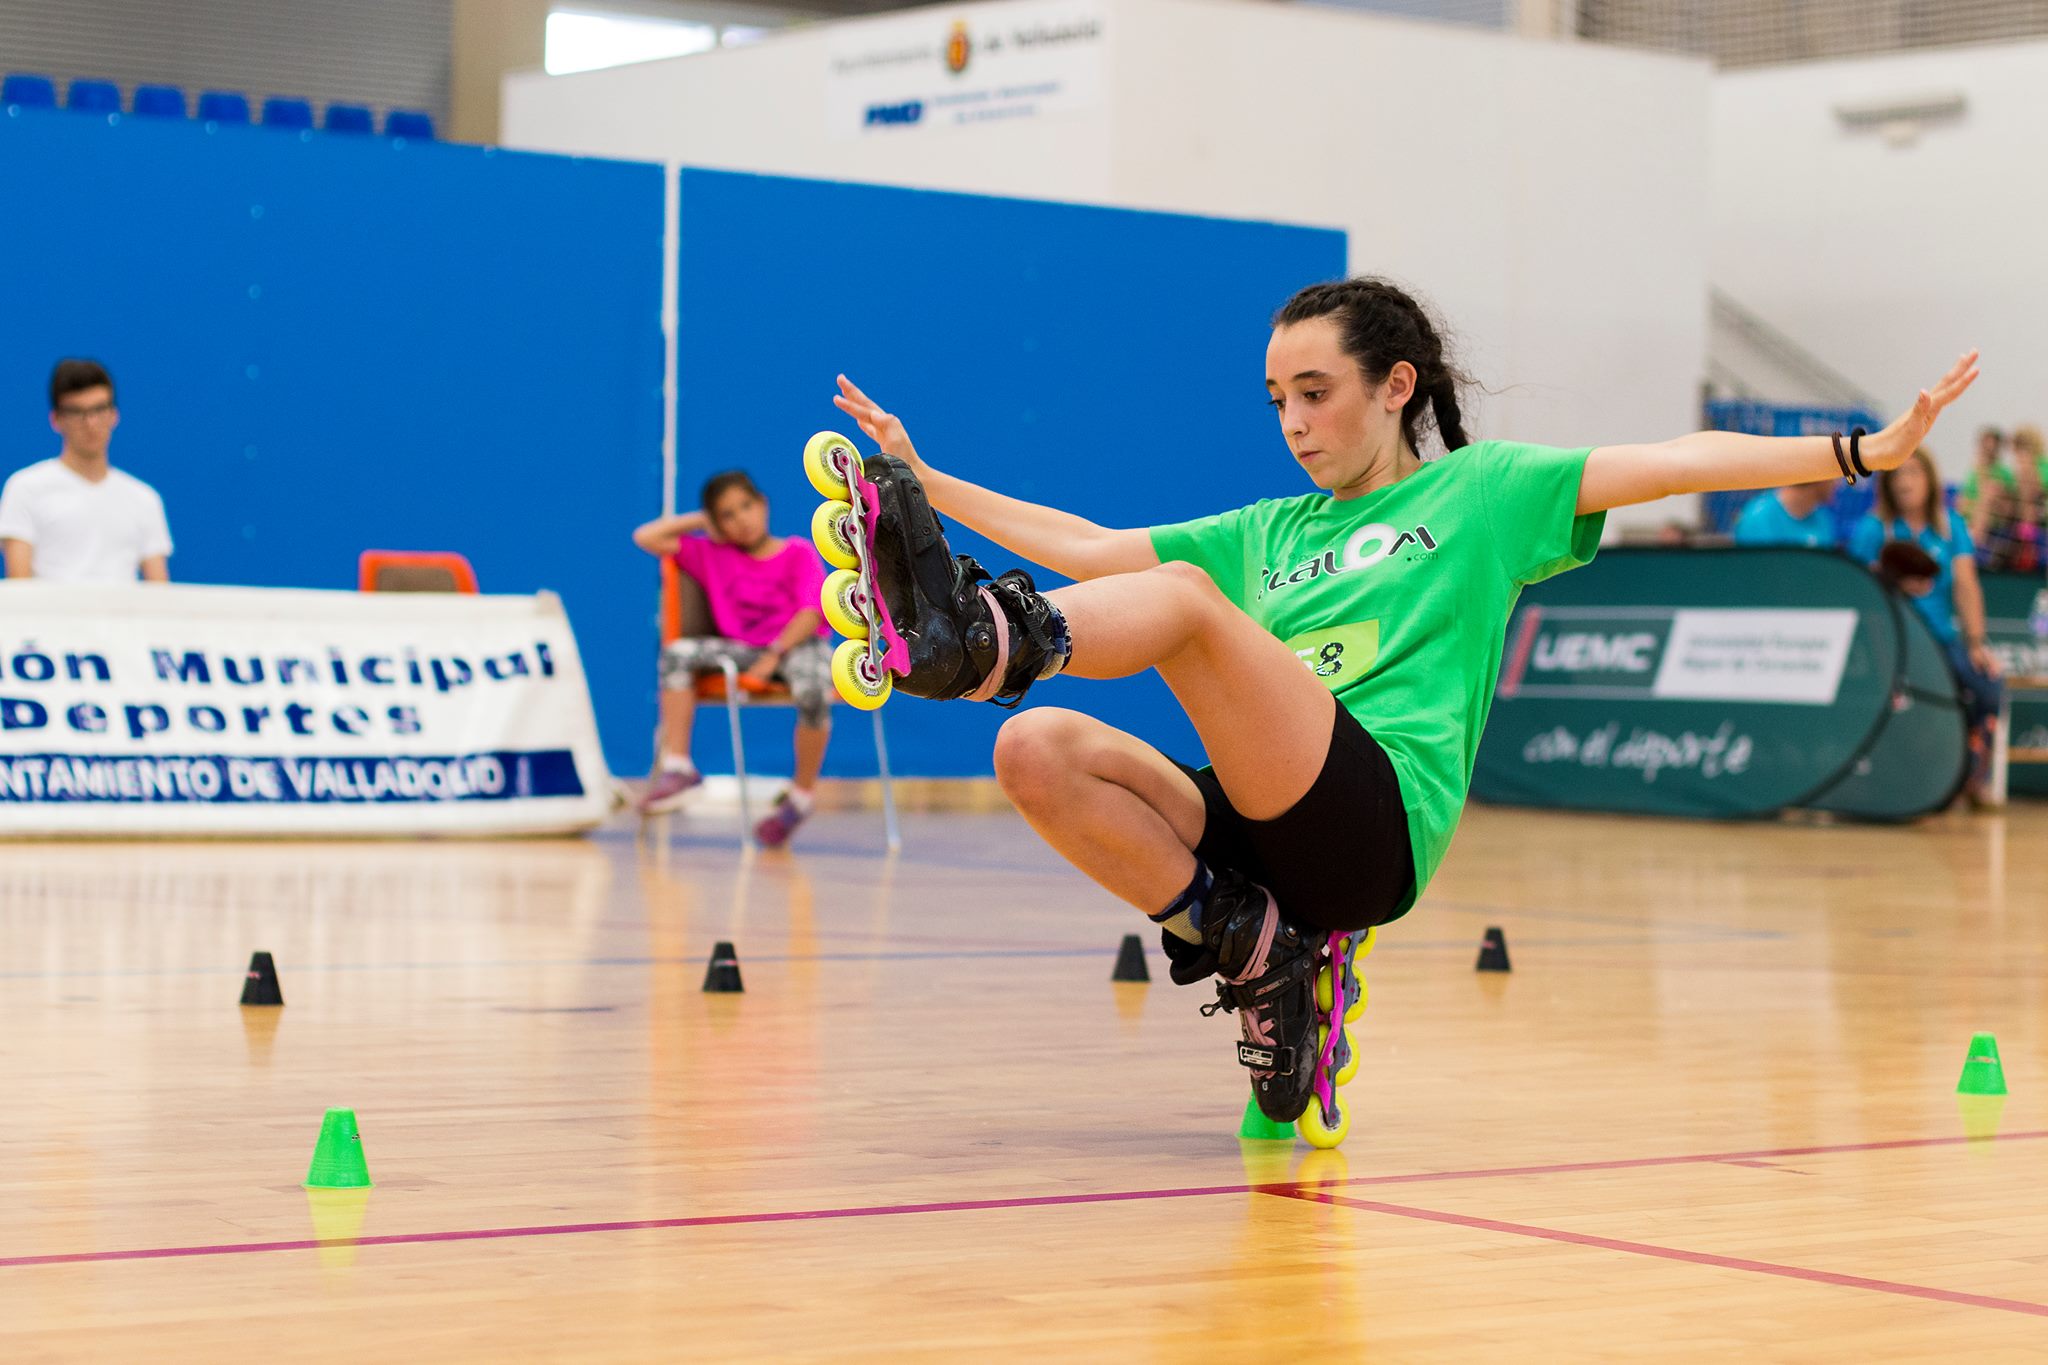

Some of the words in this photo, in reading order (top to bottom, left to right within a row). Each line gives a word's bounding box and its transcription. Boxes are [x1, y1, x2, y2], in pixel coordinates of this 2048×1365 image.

[0, 642, 112, 681] ón
[150, 642, 556, 692] Municipal
[1533, 632, 1656, 671] UEMC
[0, 697, 422, 739] Deportes
[1611, 719, 1753, 783] deporte
[227, 759, 283, 799] DE
[281, 755, 505, 800] VALLADOLID
